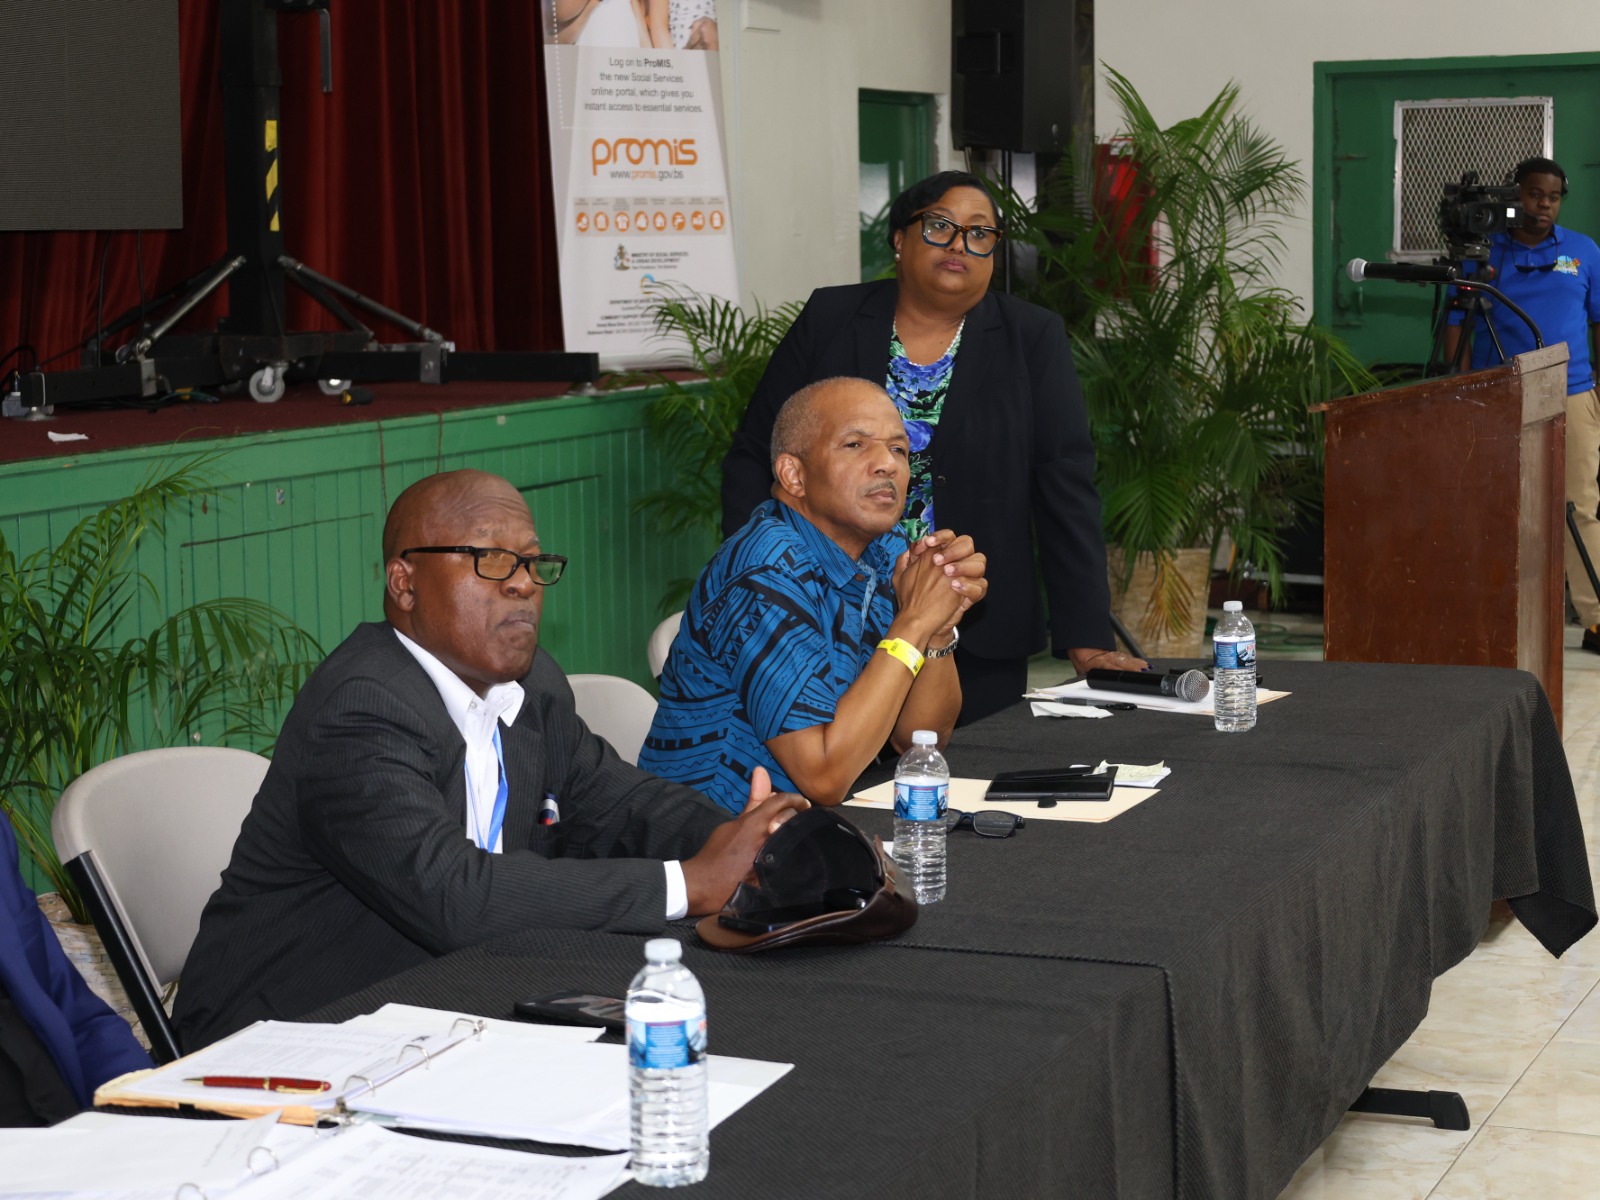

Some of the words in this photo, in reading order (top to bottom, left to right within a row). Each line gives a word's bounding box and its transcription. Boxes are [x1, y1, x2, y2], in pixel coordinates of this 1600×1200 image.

[609, 57, 624, 69] Log
[626, 59, 635, 67] on
[636, 58, 642, 67] to
[644, 58, 673, 69] ProMIS,
[599, 72, 612, 81] the
[631, 73, 651, 82] Social
[653, 73, 684, 83] Services
[591, 87, 613, 96] online
[615, 87, 638, 97] portal,
[639, 88, 659, 97] which
[661, 89, 679, 99] gives
[681, 90, 694, 99] you
[584, 102, 607, 111] instant
[608, 103, 633, 111] access
[634, 103, 642, 111] to
[643, 103, 672, 112] essential
[674, 104, 703, 113] services.
[592, 138, 698, 176] promis
[610, 169, 684, 181] www.promis.gov.bs
